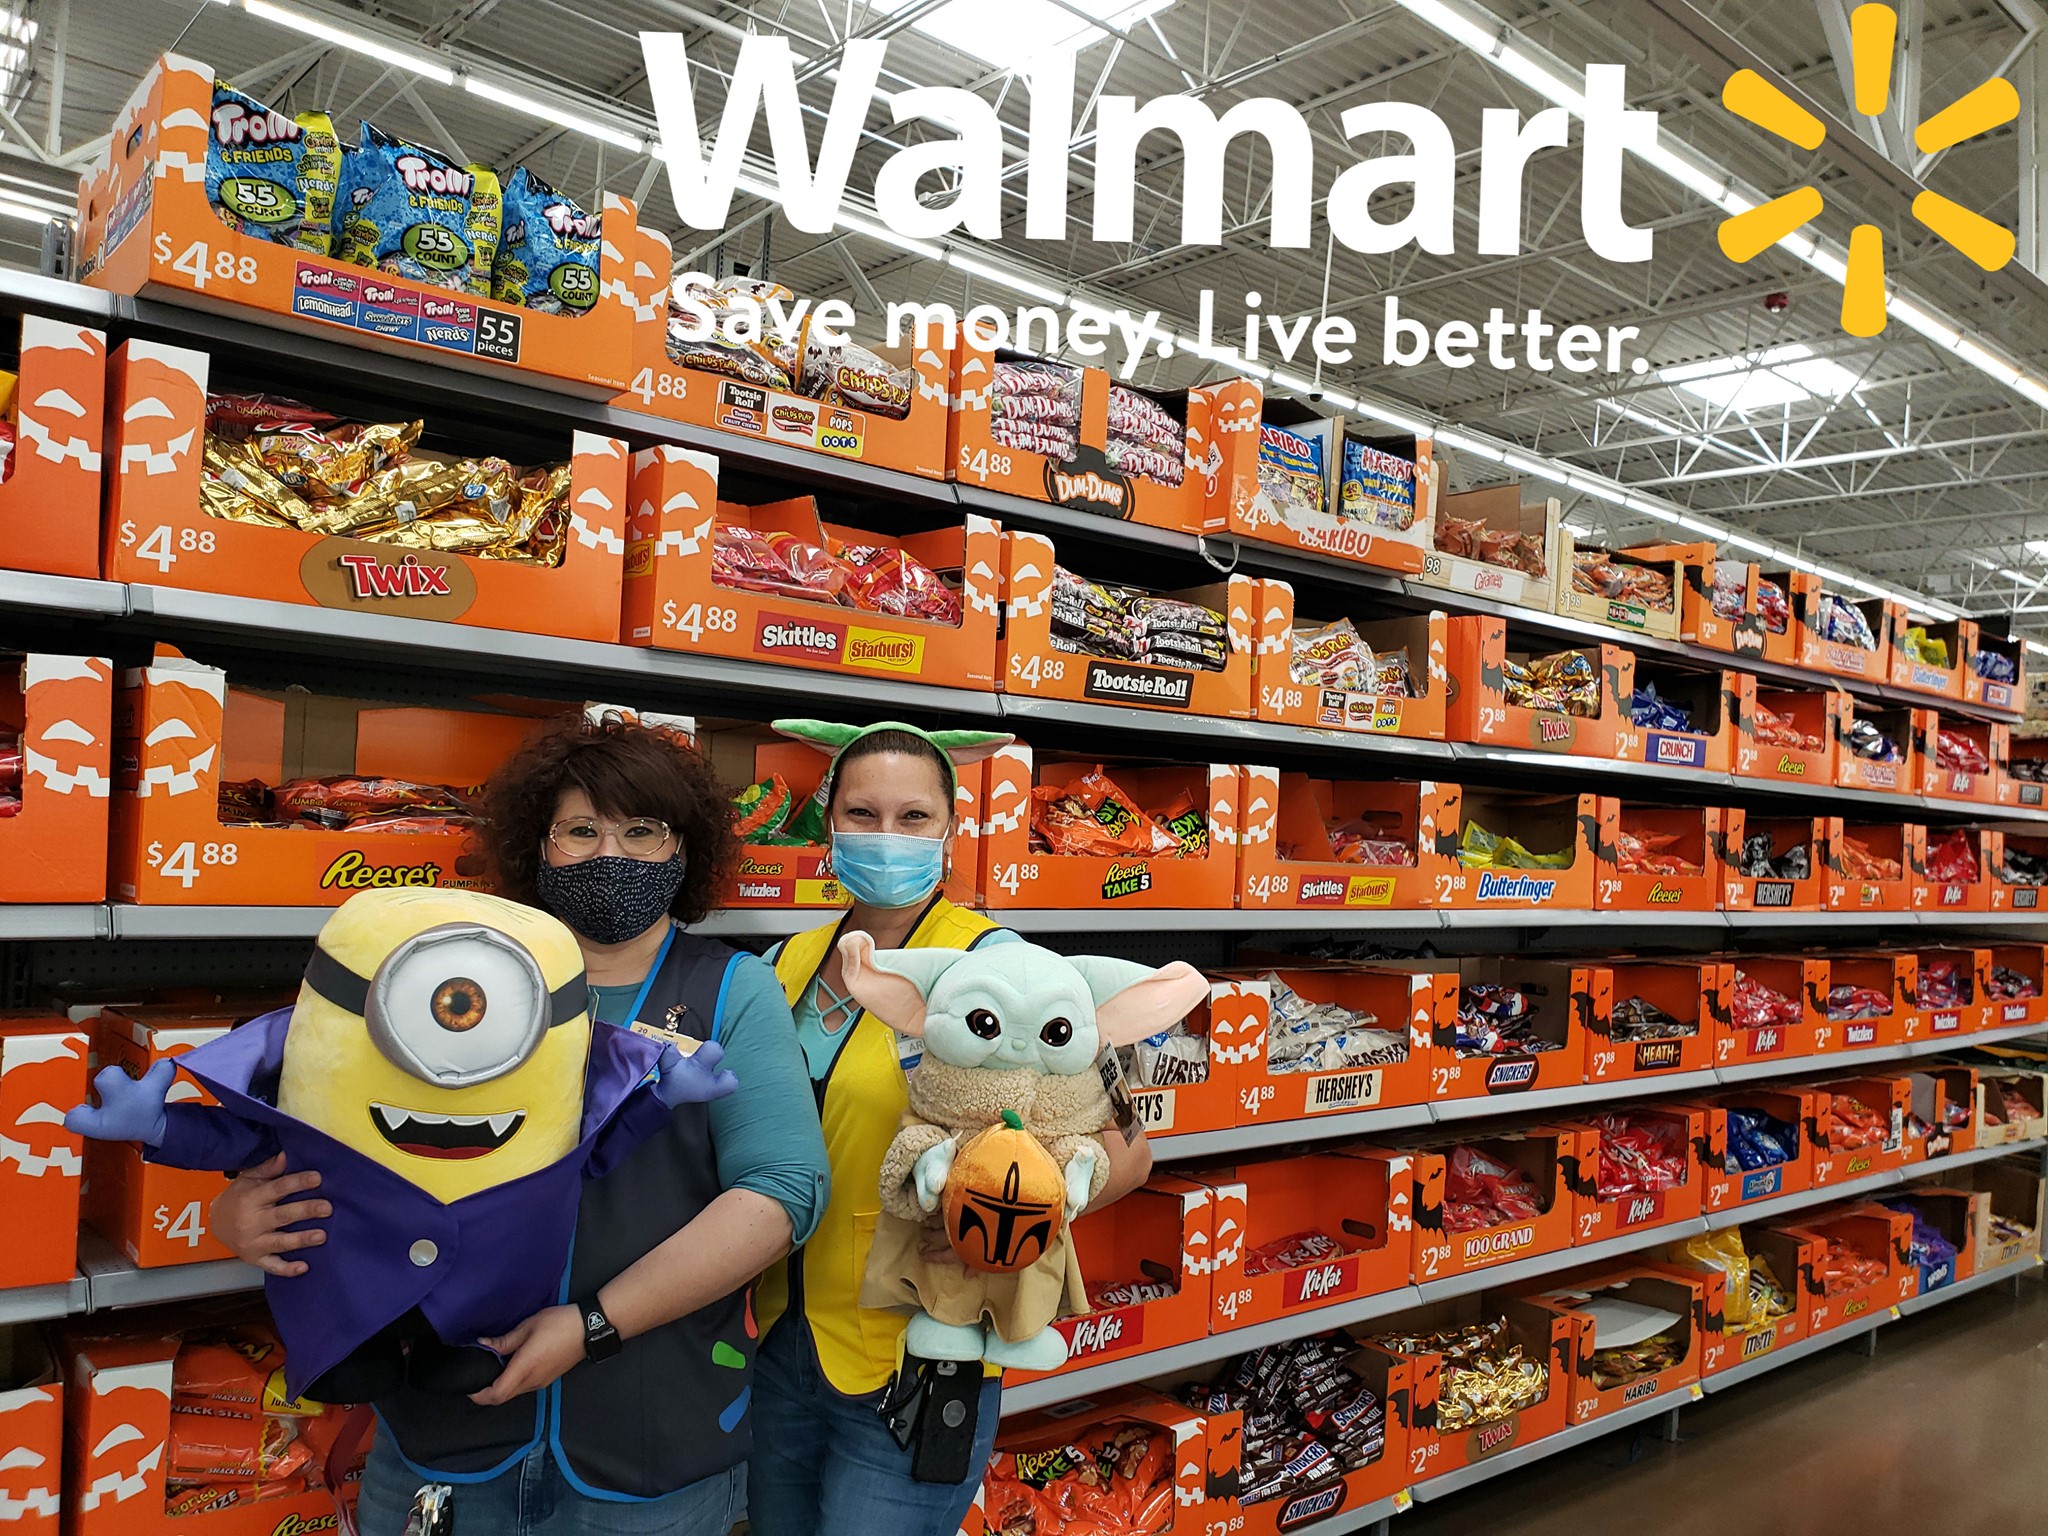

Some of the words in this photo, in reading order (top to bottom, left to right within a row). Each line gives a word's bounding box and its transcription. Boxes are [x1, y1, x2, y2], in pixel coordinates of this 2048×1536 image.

[231, 147, 293, 164] FRIENDS
[397, 156, 474, 198] Trolli
[237, 183, 277, 206] 55
[236, 204, 283, 217] COUNT
[419, 197, 463, 214] FRIENDS
[417, 229, 455, 251] 55
[415, 249, 457, 265] COUNT
[299, 269, 334, 288] Trolli
[562, 269, 592, 290] 55
[364, 286, 395, 303] Trolli
[561, 290, 593, 302] COUNT
[424, 301, 454, 317] Trolli
[480, 315, 515, 344] 55
[477, 341, 514, 357] pieces
[729, 385, 762, 402] Tootsie
[734, 396, 755, 409] Roll
[829, 416, 854, 431] POPS
[821, 435, 858, 448] DOTS
[1261, 427, 1311, 458] ARIBO
[340, 554, 453, 599] Twix
[762, 621, 837, 650] Skittles
[851, 639, 915, 660] Starburst
[1540, 717, 1570, 742] Twix
[1659, 741, 1693, 759] CRUNCH
[1777, 755, 1806, 776] Reese's
[319, 850, 442, 890] Reese's
[442, 879, 497, 889] PUMPKINS
[738, 858, 784, 875] Reese's
[1105, 860, 1149, 884] Reese's
[737, 882, 781, 897] Twizzlers
[1104, 882, 1139, 898] TAKE
[1140, 874, 1150, 890] 5
[1301, 879, 1344, 900] Skittles
[1350, 880, 1390, 899] Starburst
[1477, 872, 1556, 905] Butterfinger
[1648, 882, 1683, 903] Reese's
[1642, 1043, 1675, 1063] HEATH
[1491, 1064, 1532, 1085] SNICKERS
[1315, 1073, 1373, 1104] HERSHEY'S
[1846, 1156, 1872, 1174] Reese's
[1626, 1196, 1656, 1225] KitKat
[1463, 1237, 1490, 1259] 100
[1492, 1225, 1534, 1253] GRAND
[1299, 1264, 1343, 1301] KitKat
[1842, 1298, 1869, 1317] Reese's
[1067, 1314, 1123, 1358] KitKat
[1624, 1379, 1658, 1403] HARIBO
[1478, 1420, 1513, 1453] Twix
[208, 1466, 234, 1475] SNACK
[166, 1487, 218, 1518] ssorted
[1285, 1487, 1339, 1522] SNICKERS
[271, 1512, 339, 1536] Reese
